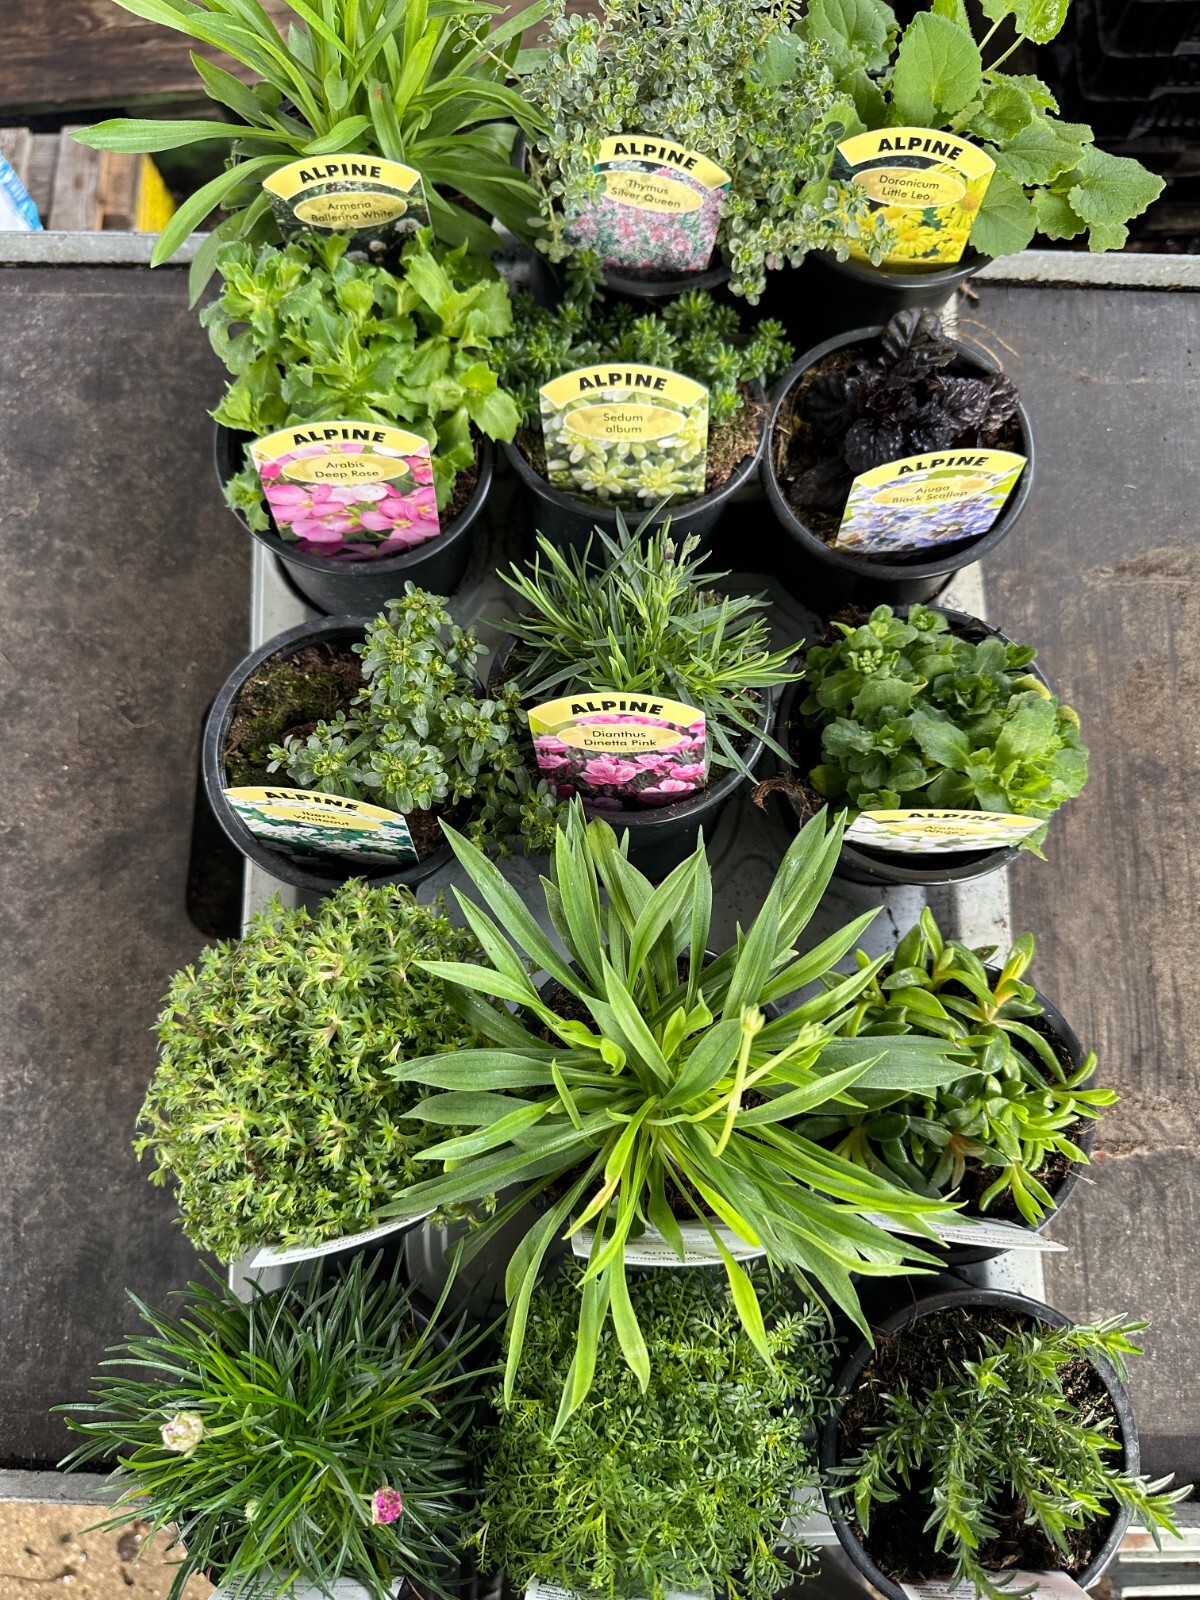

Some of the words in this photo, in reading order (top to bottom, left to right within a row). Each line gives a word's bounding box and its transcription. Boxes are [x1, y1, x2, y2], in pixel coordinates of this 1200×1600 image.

[877, 137, 964, 161] ALPINE
[613, 142, 698, 171] ALPINE
[299, 163, 382, 184] ALPINE
[627, 179, 669, 195] Thymus
[878, 174, 940, 190] Doronicum
[610, 186, 641, 200] Silver
[643, 193, 681, 208] Queen
[881, 187, 908, 199] Little
[910, 190, 930, 201] Leo
[327, 201, 372, 210] Armeria
[311, 212, 359, 222] Ballerina
[363, 210, 394, 219] White
[579, 372, 668, 392] ALPINE
[603, 412, 643, 422] Sedum
[605, 424, 642, 433] album
[293, 428, 387, 446] ALPINE
[325, 461, 365, 469] Arabis
[897, 456, 990, 476] ALPINE
[314, 470, 348, 479] Deep
[914, 485, 950, 494] Ajuga
[891, 495, 922, 504] Black
[926, 491, 968, 500] Scallop
[571, 700, 664, 715] ALPINE
[592, 730, 646, 738] Dianthus
[264, 791, 359, 811] ALPINE
[908, 813, 1006, 822] ALPINE
